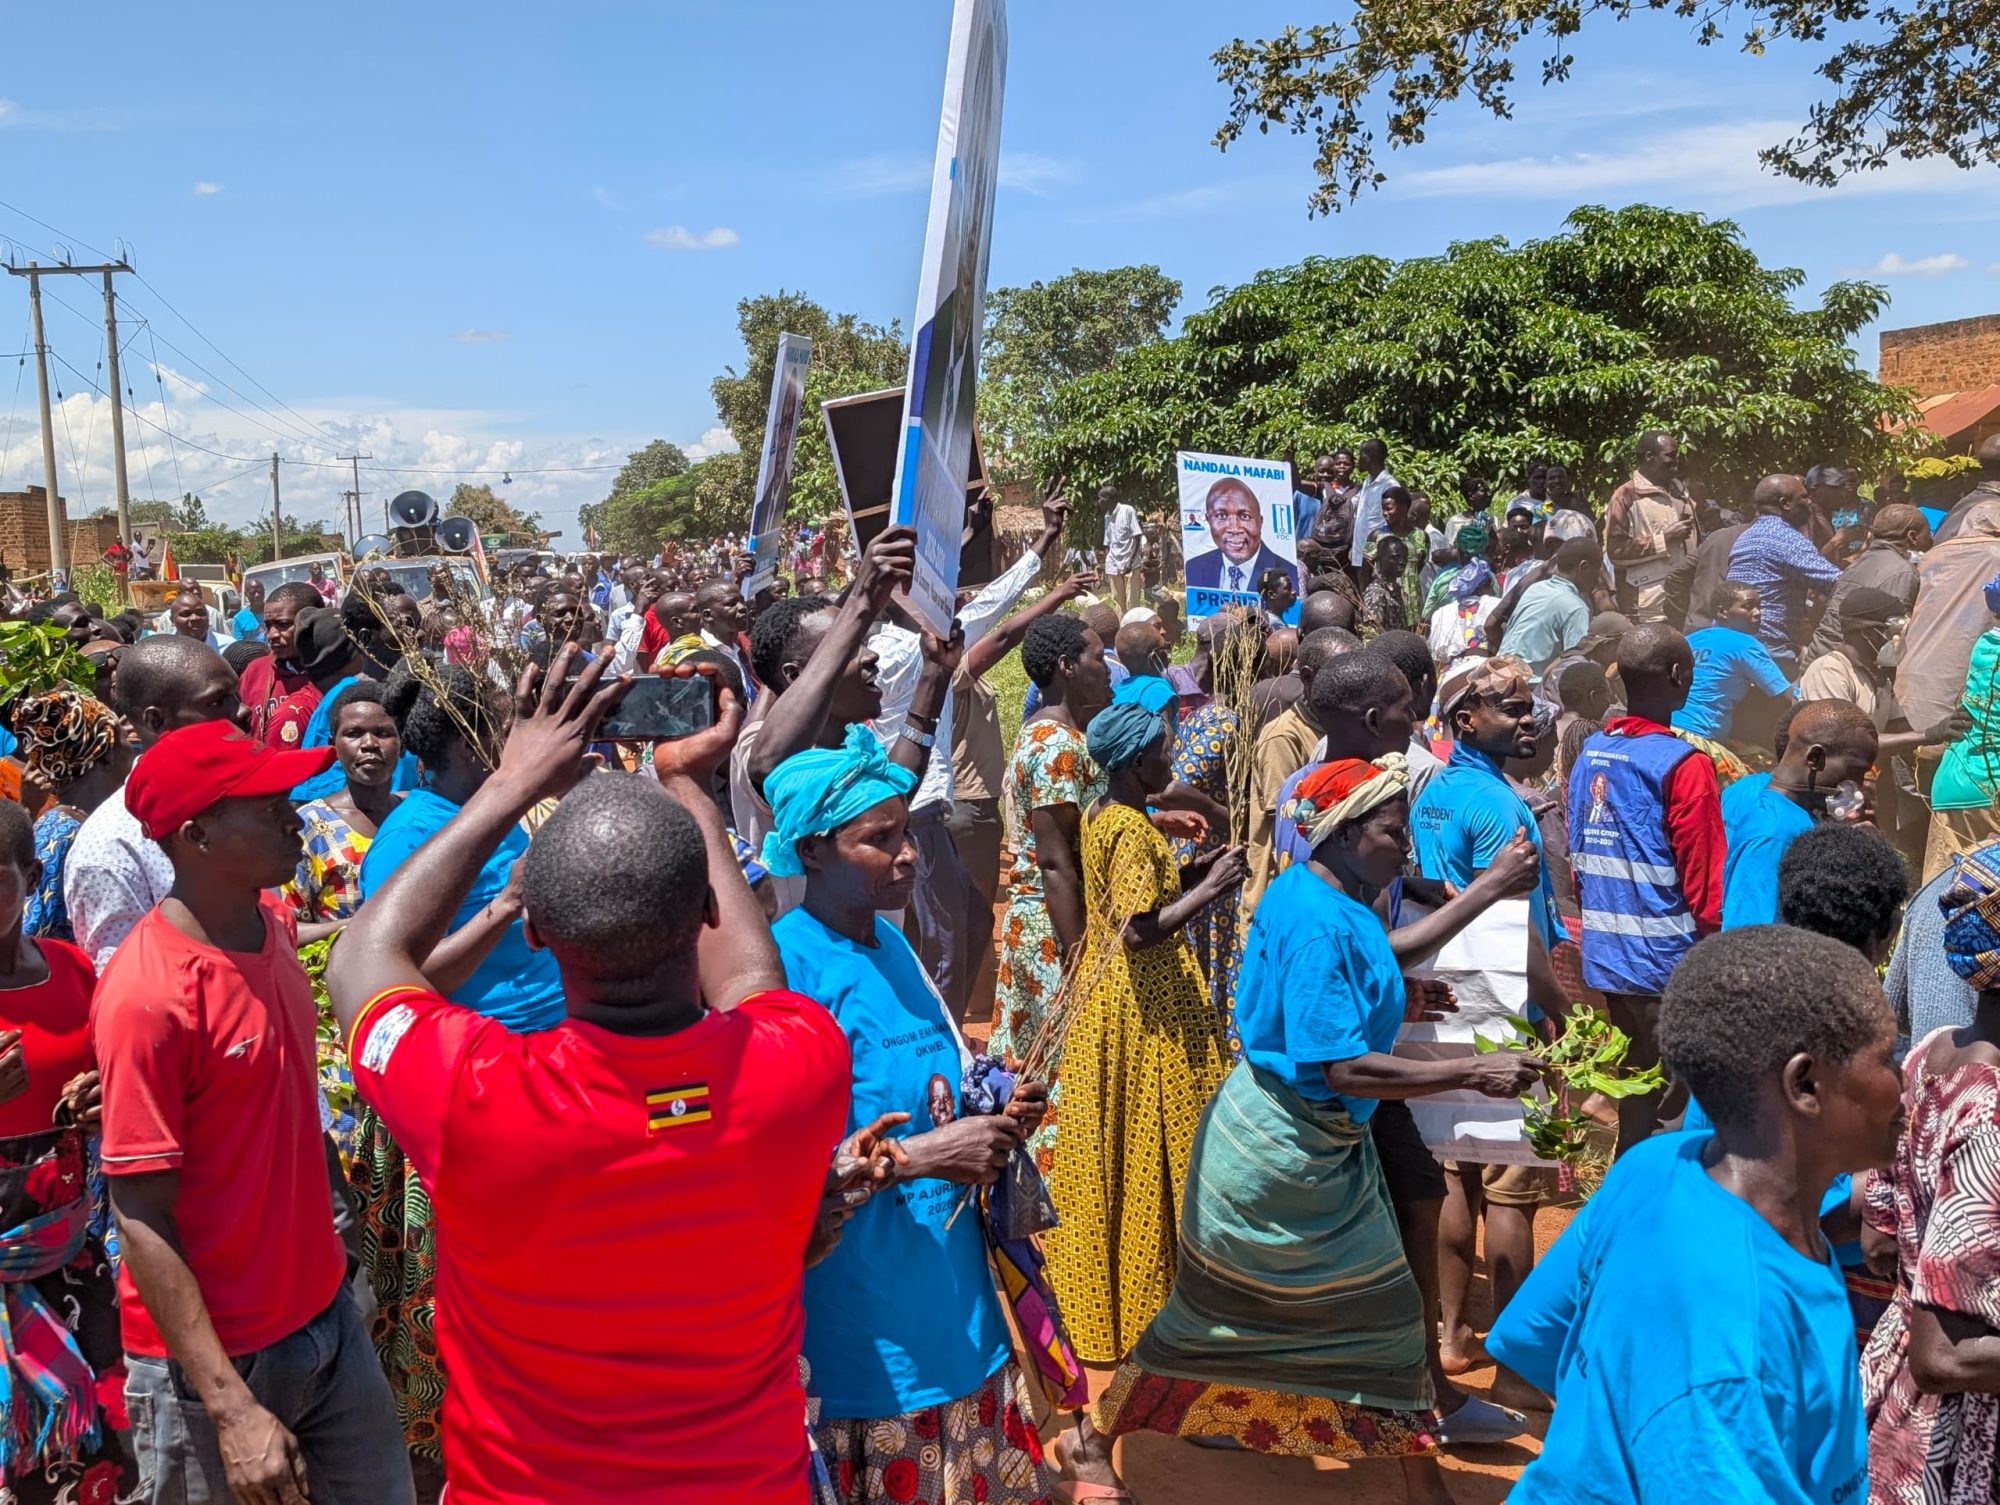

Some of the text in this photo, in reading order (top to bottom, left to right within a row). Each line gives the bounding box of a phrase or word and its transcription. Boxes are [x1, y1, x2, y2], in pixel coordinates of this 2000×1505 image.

[1184, 459, 1285, 480] NANDALA MAFABI
[881, 1031, 918, 1049] ONGOM
[915, 1040, 948, 1058] OKWEL
[895, 1192, 915, 1207] MP
